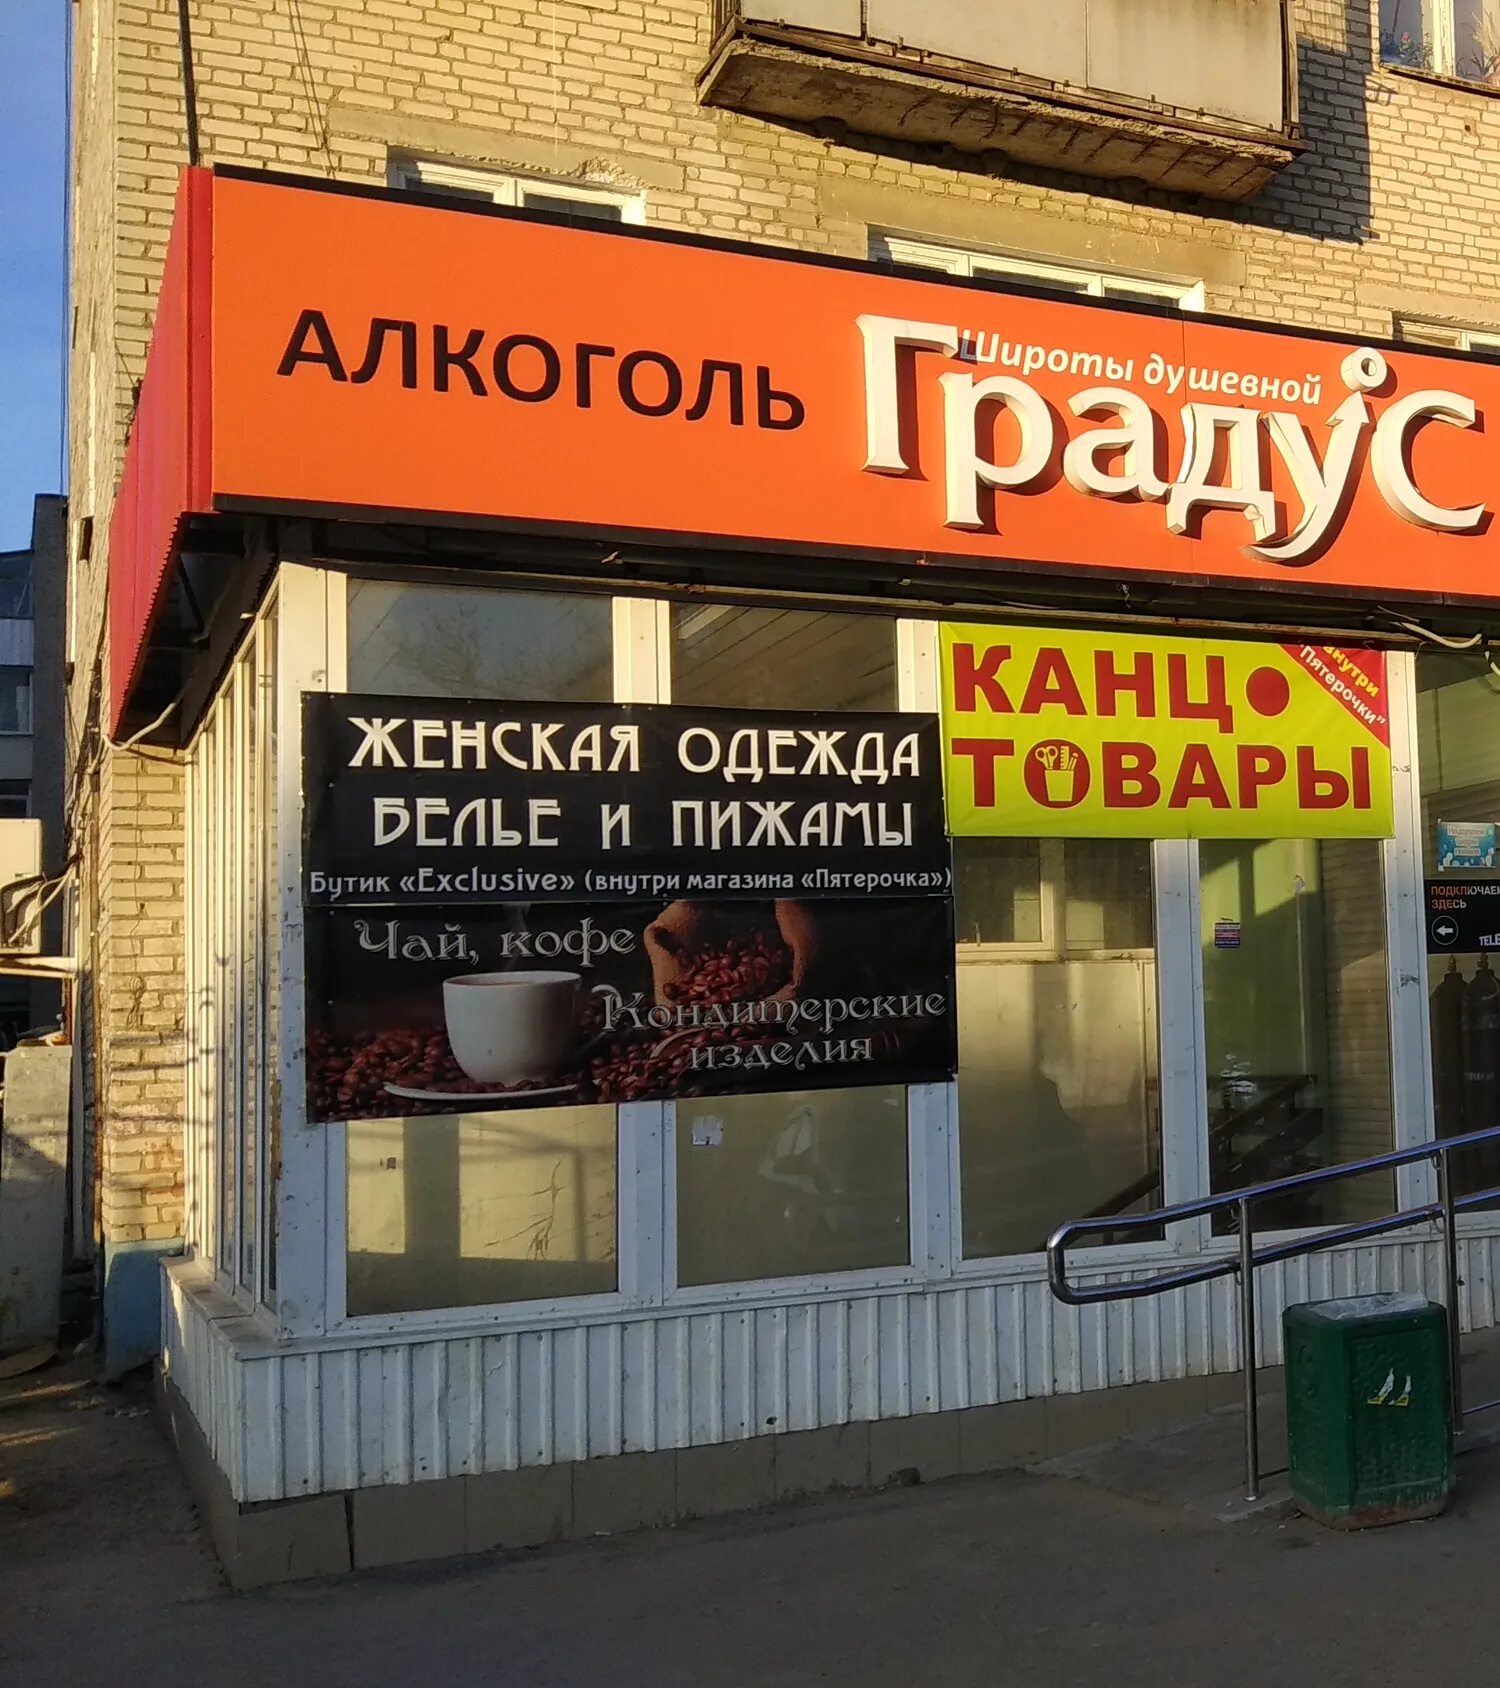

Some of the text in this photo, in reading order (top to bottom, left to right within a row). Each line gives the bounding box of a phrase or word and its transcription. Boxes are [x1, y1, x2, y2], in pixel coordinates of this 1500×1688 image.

[277, 309, 806, 431] АЛКОГОЛЬ
[960, 328, 1322, 405] Широты душевной
[347, 717, 921, 785] ЖЕНСКАЯ ОДЕЖДА
[951, 737, 1373, 810] ТОВАРЫ
[372, 797, 562, 848] БЕЛЬЕ
[671, 800, 913, 851] ПИЖАМЫ
[310, 865, 952, 901] Бутик «Exclusive» (внутри магазина «Пятерочка»)
[1431, 900, 1467, 910] ЗДЕСЬ
[353, 916, 638, 968] Чай, кофе
[601, 990, 947, 1035] Кондитерские
[689, 1037, 875, 1072] изделия
